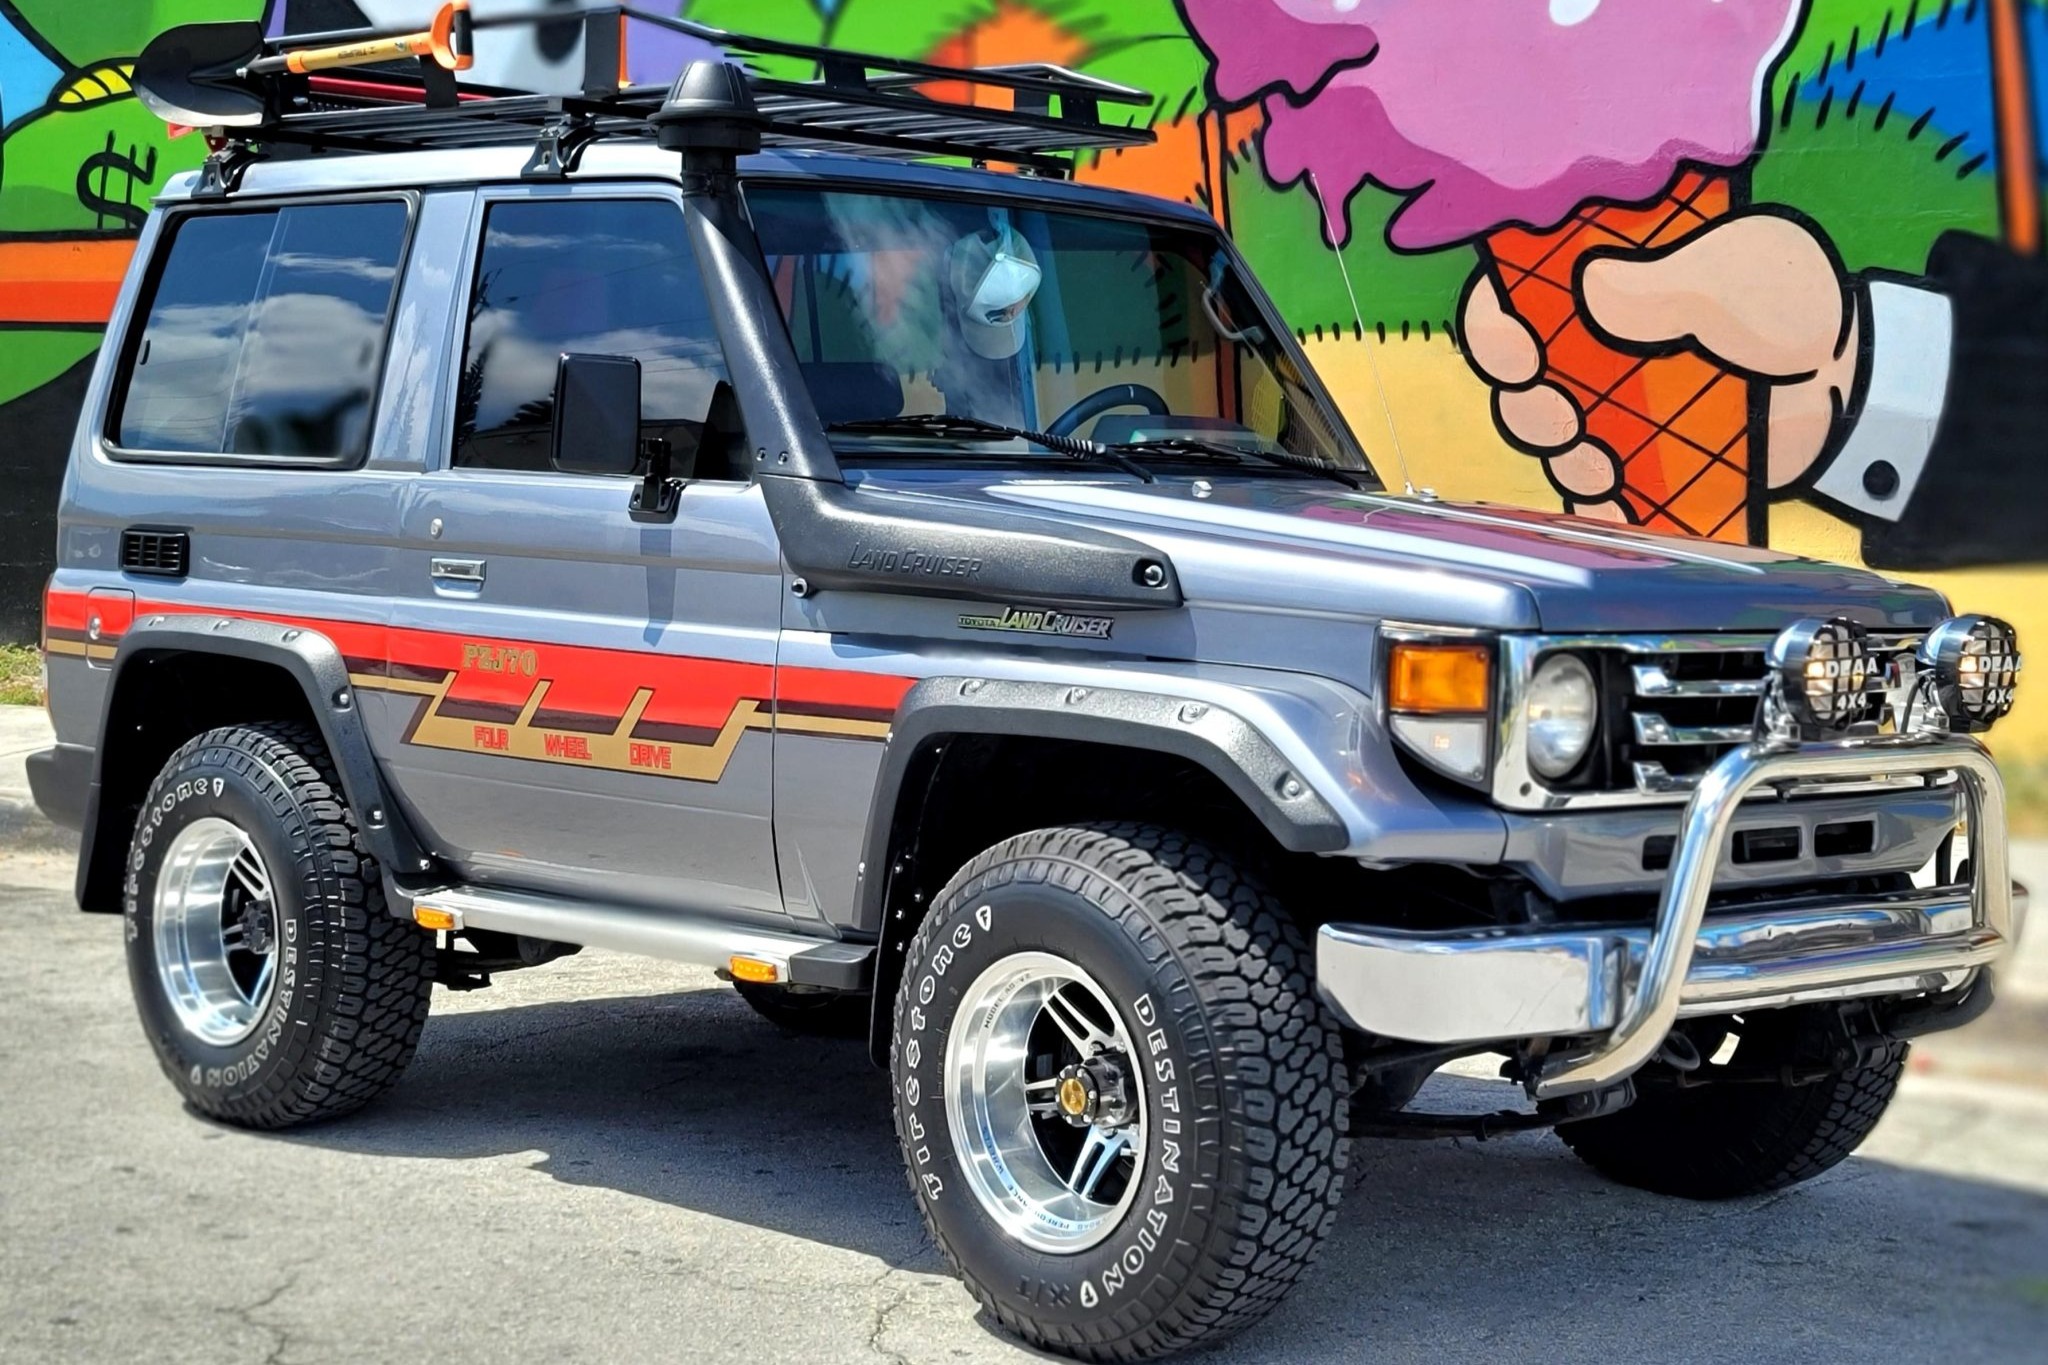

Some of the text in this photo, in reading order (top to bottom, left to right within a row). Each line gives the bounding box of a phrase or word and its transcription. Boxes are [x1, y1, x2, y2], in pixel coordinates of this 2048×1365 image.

[848, 542, 982, 582] LAND CRUISER
[960, 616, 997, 628] TOYOTA
[463, 642, 538, 677] PZJ70
[473, 725, 672, 770] FOUR WHEEL DRIVE
[205, 919, 298, 1087] DESTINATION
[1101, 994, 1181, 1298] DESTINATION
